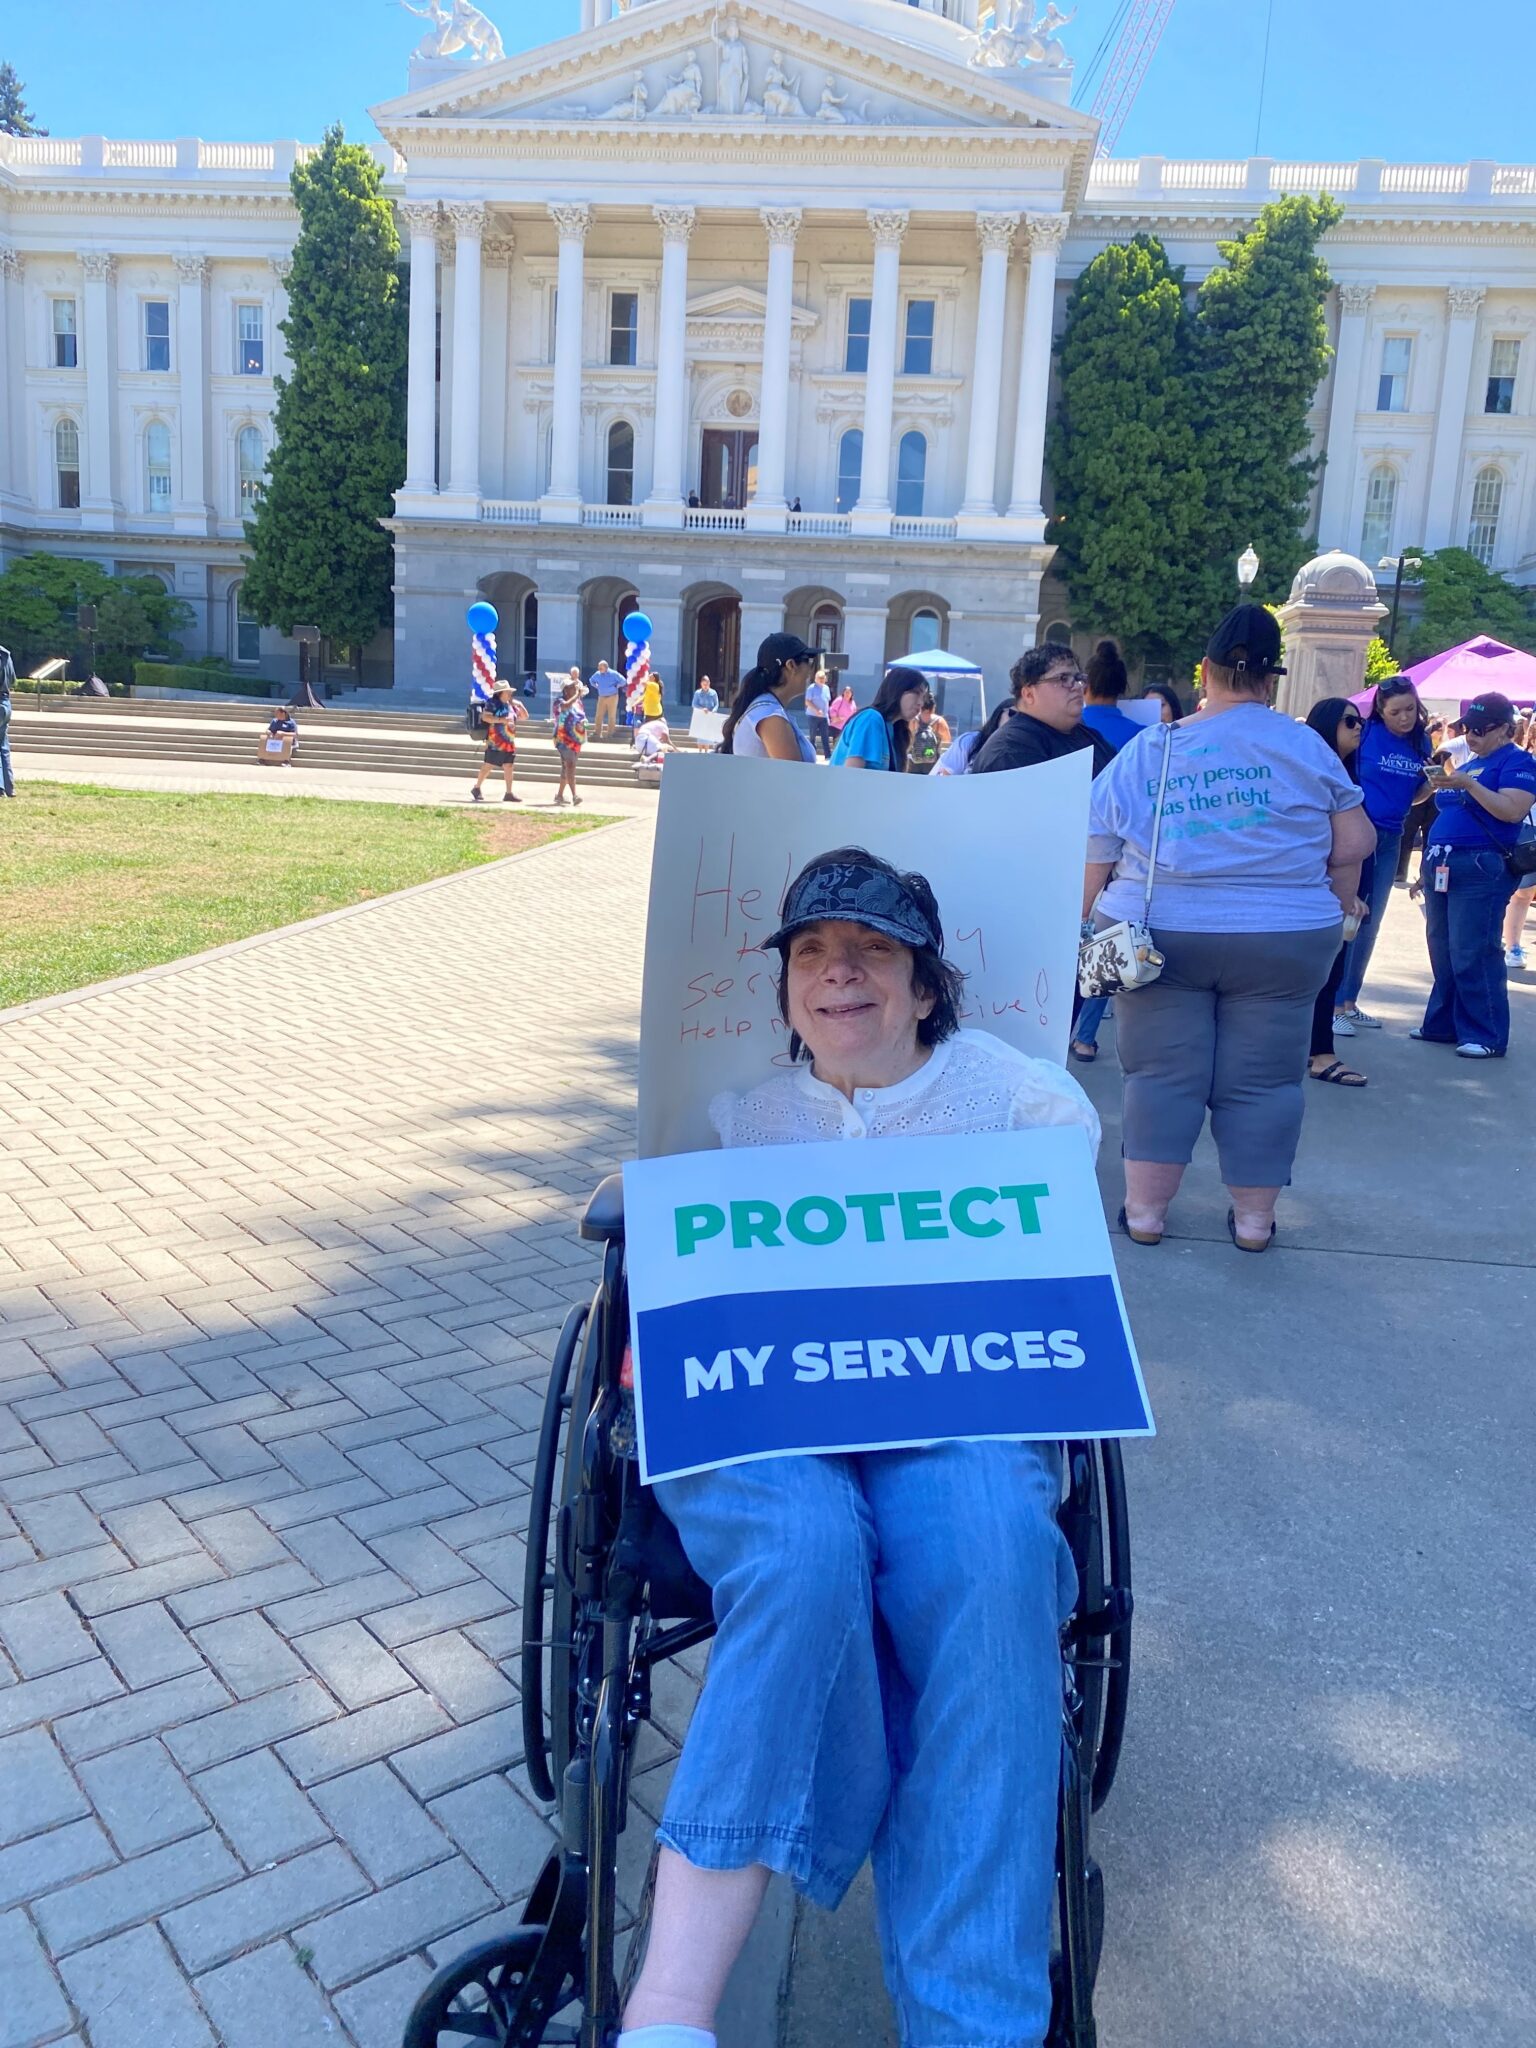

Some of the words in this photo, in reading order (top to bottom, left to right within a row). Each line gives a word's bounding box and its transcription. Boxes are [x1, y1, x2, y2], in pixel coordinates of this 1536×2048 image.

[1188, 793, 1222, 811] the
[1226, 786, 1272, 807] right
[1203, 765, 1272, 789] person
[674, 1183, 1050, 1257] PROTECT
[683, 1345, 775, 1399] MY
[791, 1329, 1086, 1383] SERVICES
